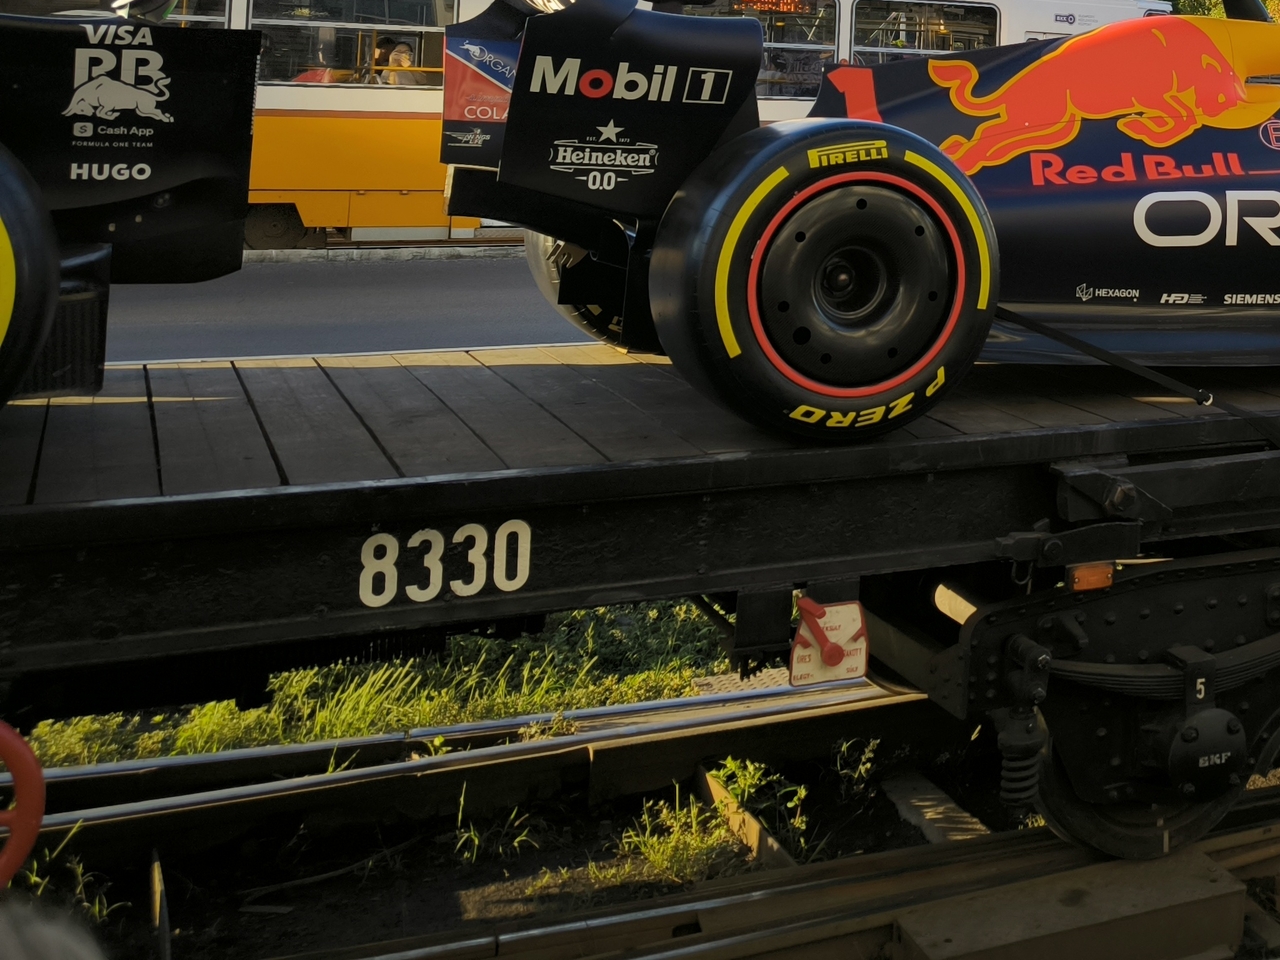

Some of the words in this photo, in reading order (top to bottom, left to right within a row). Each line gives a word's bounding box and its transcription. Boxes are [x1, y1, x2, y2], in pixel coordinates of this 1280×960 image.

[79, 24, 153, 45] VISA
[529, 55, 678, 102] Mobil
[827, 67, 883, 123] 1
[98, 126, 127, 135] Cash
[129, 126, 154, 137] App
[554, 146, 652, 167] Heineken
[807, 140, 888, 169] PIRELLI
[70, 163, 152, 181] HUGO
[587, 171, 616, 190] 0.0
[1029, 152, 1137, 186] Red
[1143, 152, 1245, 180] Bull
[1095, 288, 1139, 298] HEXAGON
[925, 366, 945, 397] P
[789, 392, 915, 427] ZERO
[359, 519, 531, 608] 8330
[1196, 677, 1206, 700] 5
[1198, 751, 1232, 768] SKF
